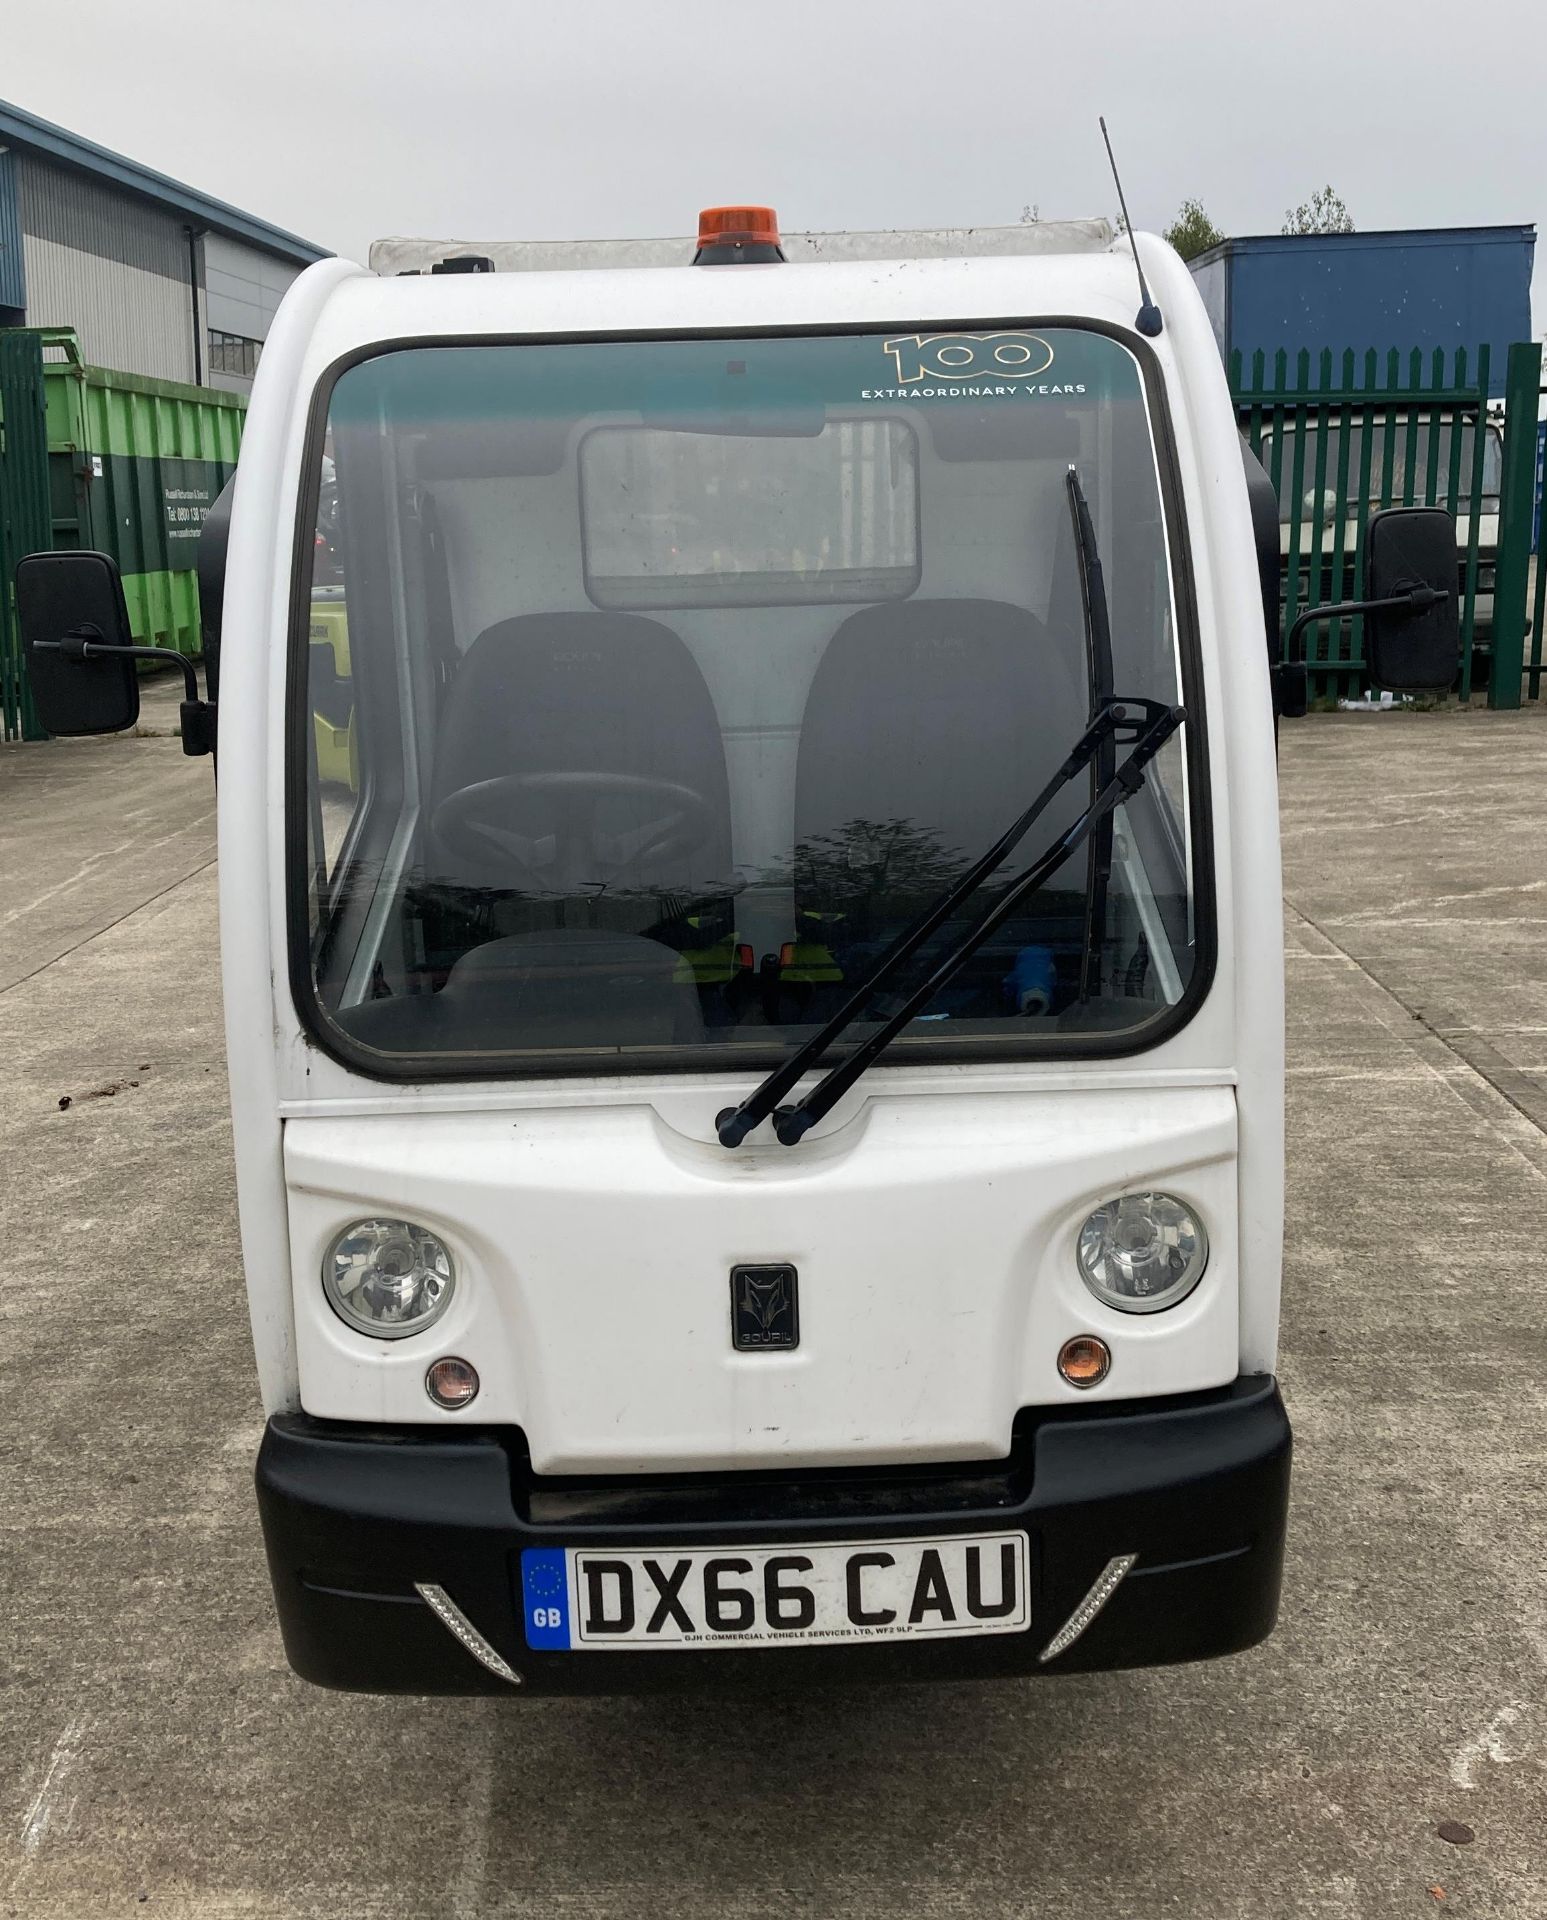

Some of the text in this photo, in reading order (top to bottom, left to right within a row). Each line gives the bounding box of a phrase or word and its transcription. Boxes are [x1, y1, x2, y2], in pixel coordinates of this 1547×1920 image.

[884, 333, 1054, 384] 100
[861, 384, 1086, 399] EXTRAORDINARY YEARS
[582, 1543, 1016, 1634] DX66 CAU
[533, 1608, 561, 1628] GB
[705, 1632, 765, 1641] COMMERCIAL
[767, 1630, 805, 1639] VEHICLE
[807, 1627, 852, 1638] SERVICES
[876, 1626, 895, 1635] WF2
